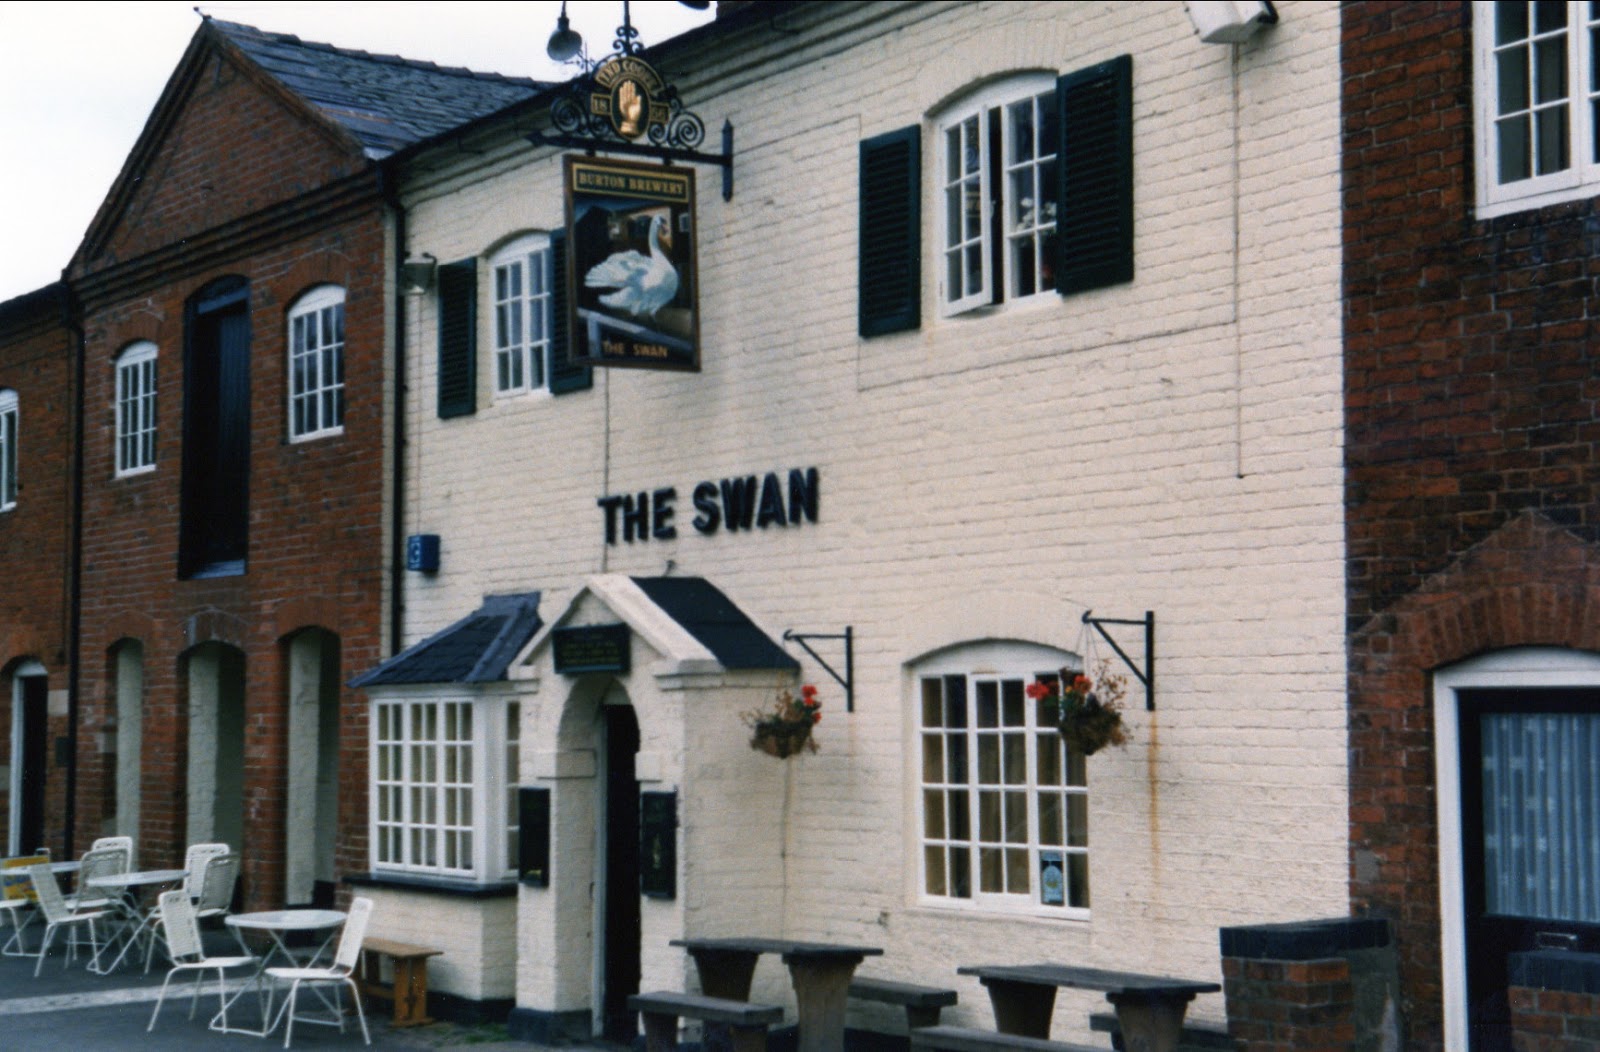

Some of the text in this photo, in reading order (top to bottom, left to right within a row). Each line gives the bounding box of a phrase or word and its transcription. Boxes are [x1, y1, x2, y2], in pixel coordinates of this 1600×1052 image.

[579, 172, 683, 194] BURTON BREWERY
[602, 340, 668, 358] THE SWAN
[597, 466, 819, 546] THE SWAN
